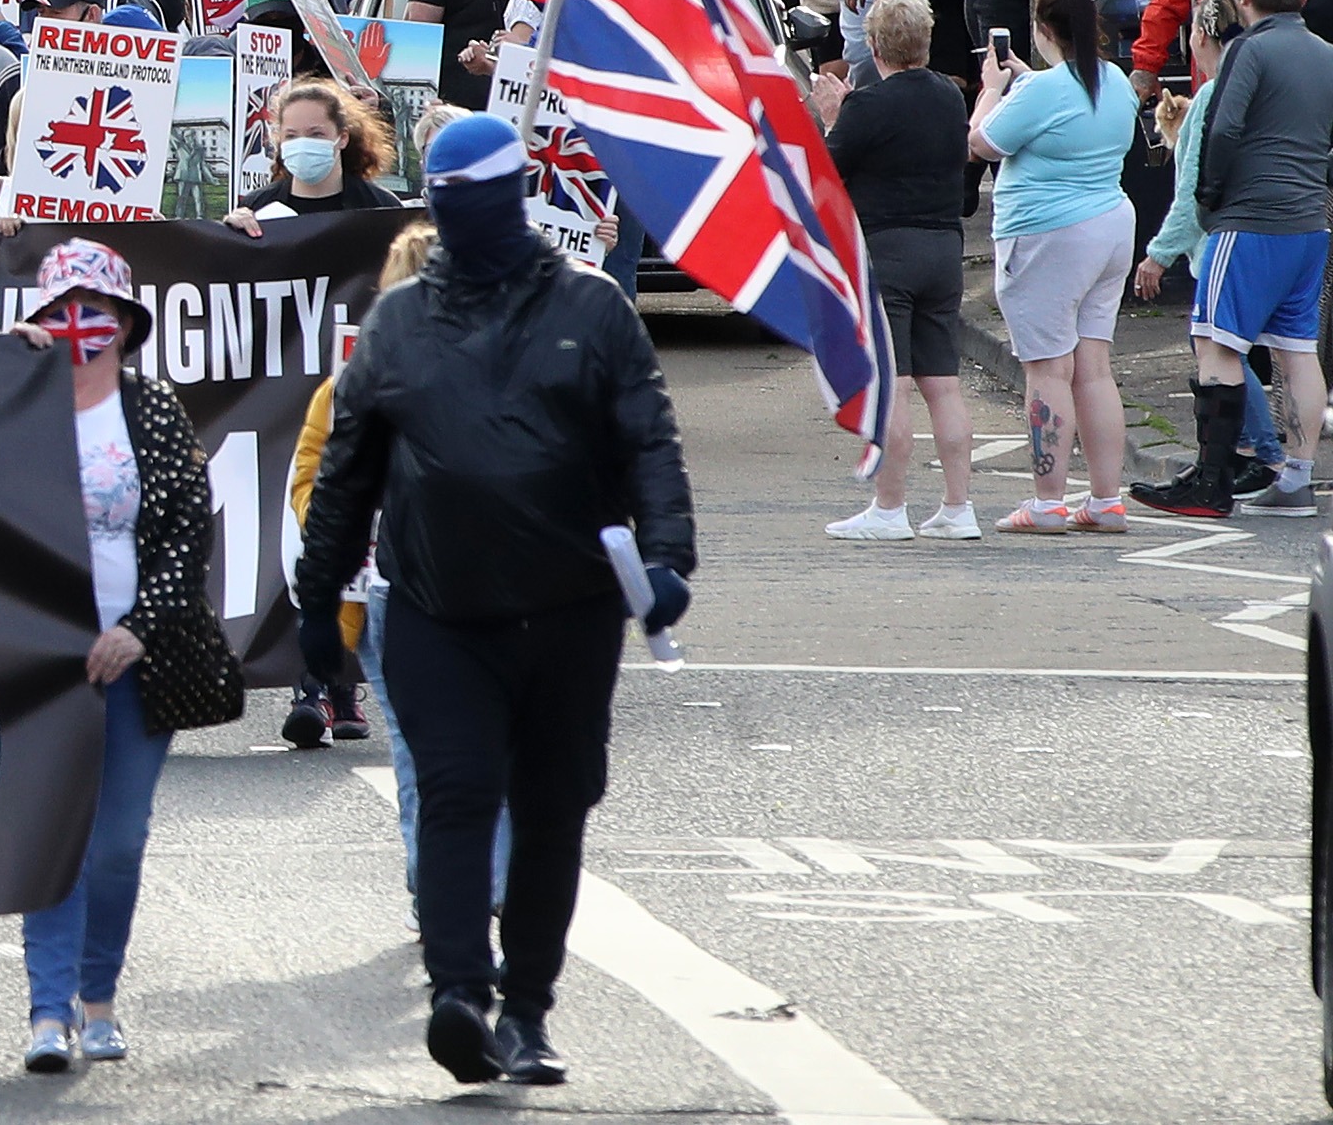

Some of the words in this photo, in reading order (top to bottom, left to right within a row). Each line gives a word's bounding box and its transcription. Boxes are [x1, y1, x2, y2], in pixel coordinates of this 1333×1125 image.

[38, 26, 177, 63] REMOVE
[251, 31, 281, 55] STOP
[35, 54, 52, 71] THE
[52, 56, 95, 75] NORTHERN
[97, 60, 130, 79] IRELAND
[131, 65, 172, 84] PROTOCOL
[241, 54, 255, 74] THE
[256, 56, 289, 77] PROTOCOL
[242, 171, 251, 189] TO
[14, 193, 153, 222] REMOVE
[559, 227, 591, 254] THE
